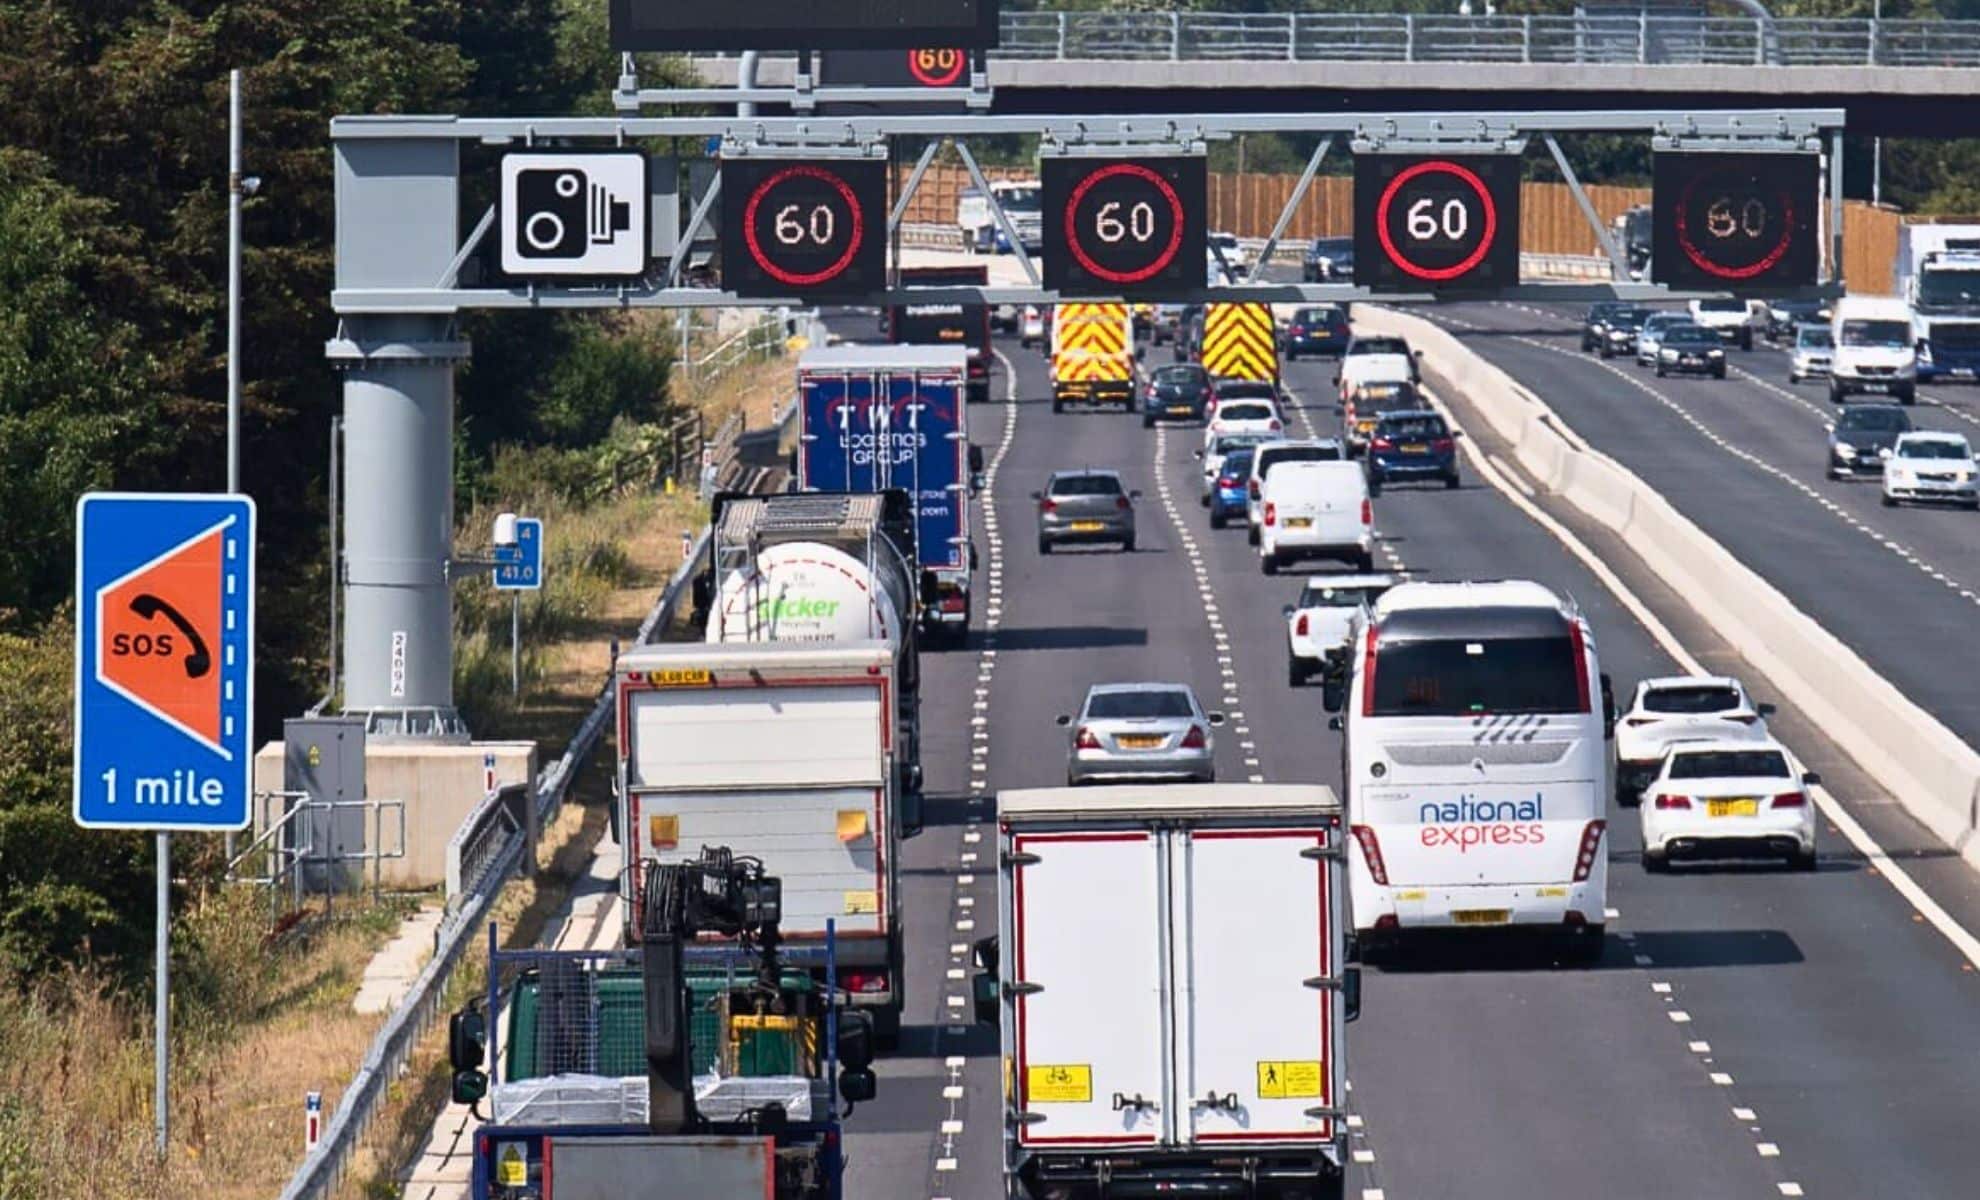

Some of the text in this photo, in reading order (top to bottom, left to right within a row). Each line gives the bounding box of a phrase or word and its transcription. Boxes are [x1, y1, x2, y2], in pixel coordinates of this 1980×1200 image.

[918, 49, 955, 70] 60
[776, 205, 834, 244] 60
[1096, 202, 1154, 242] 60
[1407, 198, 1468, 241] 60
[1707, 198, 1766, 238] 60
[839, 433, 927, 449] LOGSTICS
[112, 634, 173, 656] SOS
[102, 768, 224, 806] 1 mile
[1420, 792, 1542, 822] national
[1420, 824, 1545, 853] express
